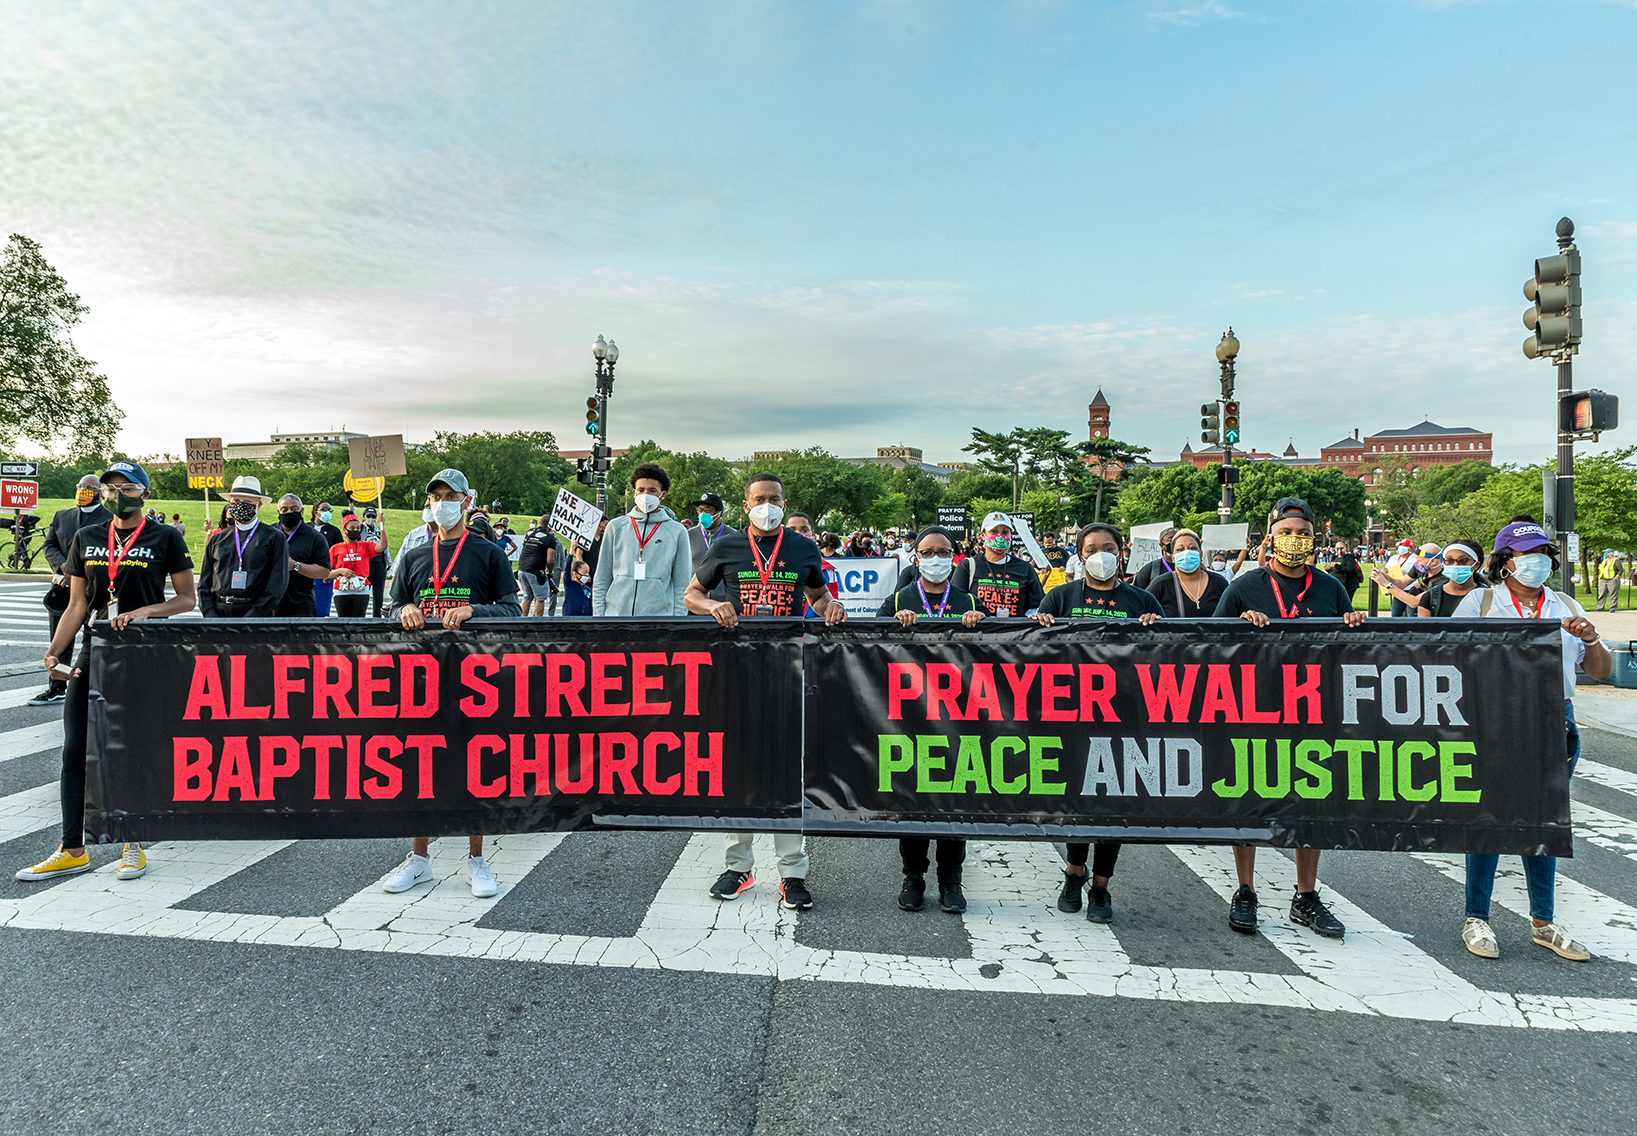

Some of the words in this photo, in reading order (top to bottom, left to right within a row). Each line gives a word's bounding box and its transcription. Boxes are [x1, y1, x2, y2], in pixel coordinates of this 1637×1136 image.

[187, 450, 221, 460] KNEE
[189, 462, 207, 474] OFF
[210, 462, 223, 474] MY
[189, 476, 224, 488] NECK
[5, 484, 35, 495] WRONG
[10, 495, 29, 505] WAY
[560, 490, 579, 511] WE
[553, 503, 584, 529] WANT
[939, 514, 964, 522] Police
[548, 518, 592, 551] JUSTICE
[1136, 539, 1160, 553] BLAC
[84, 546, 155, 560] ENOGH.
[784, 571, 798, 579] 2020
[740, 603, 792, 616] JUICE
[1113, 610, 1128, 618] 2020
[182, 653, 439, 720] ALFRED
[460, 652, 712, 718] STREET
[888, 663, 1121, 722] PRAYER
[1134, 664, 1323, 724] WALK
[1341, 664, 1469, 726] FOR
[173, 732, 447, 801] BAPTIST
[467, 732, 724, 798] CHURCH
[878, 735, 1066, 795] PEACE
[1080, 737, 1203, 797] AND
[1212, 739, 1482, 803] JUSTICE
